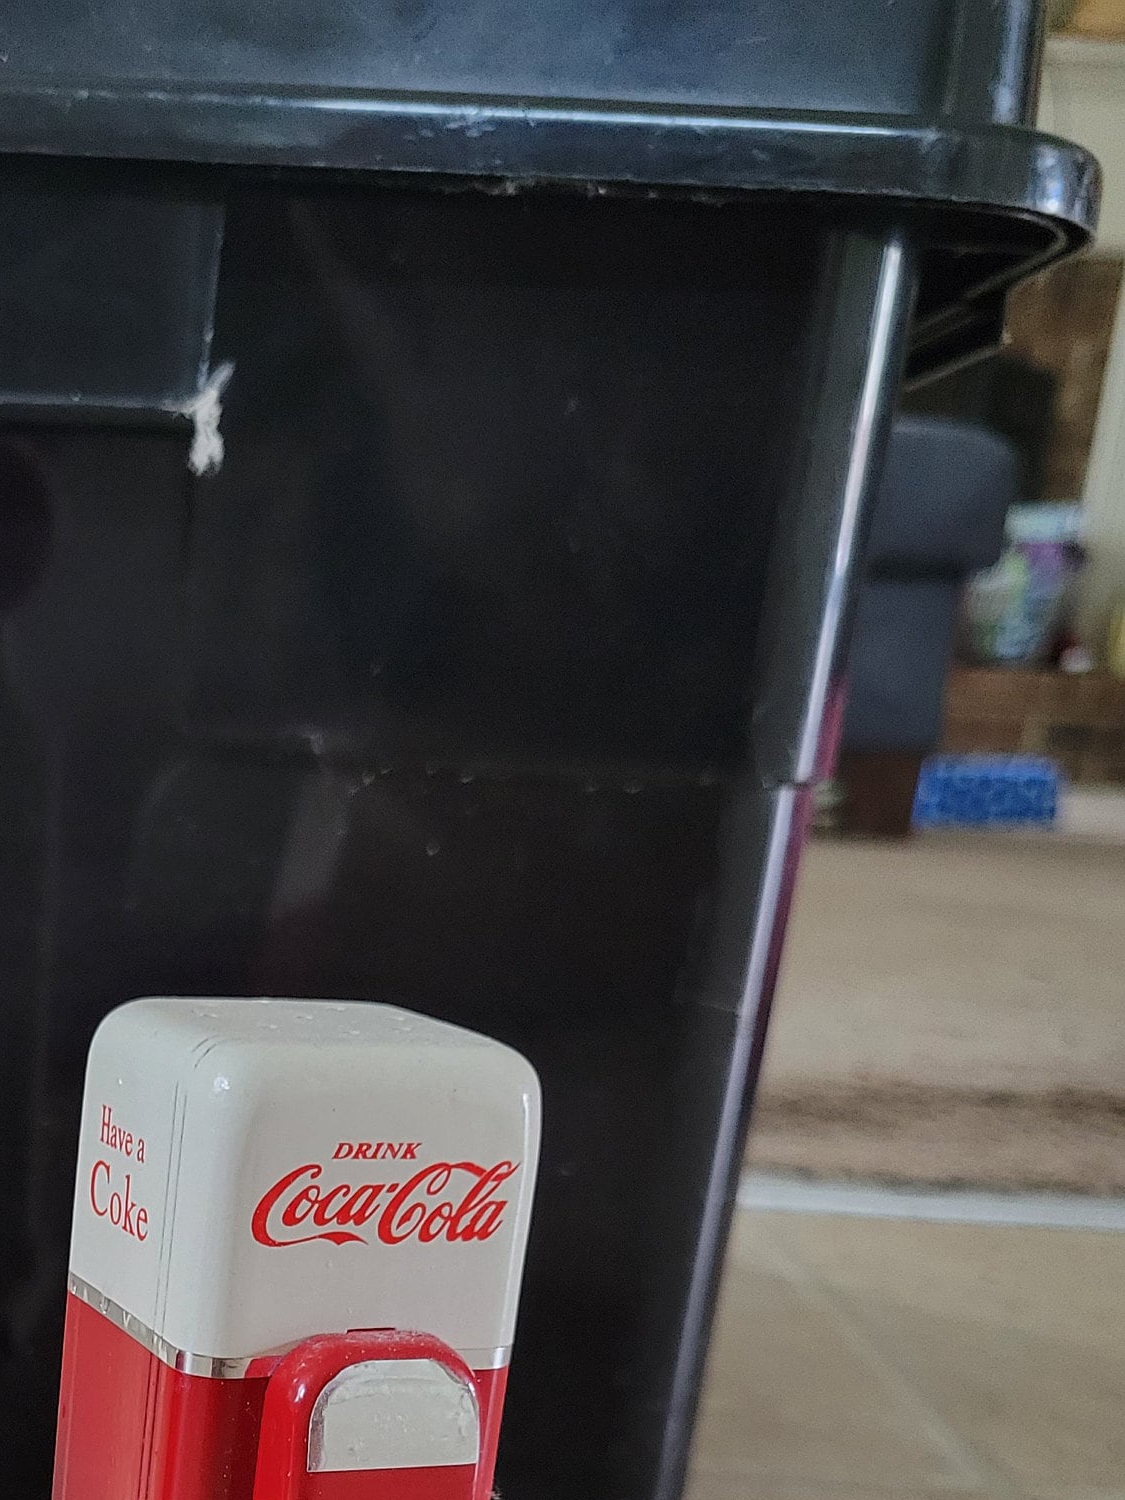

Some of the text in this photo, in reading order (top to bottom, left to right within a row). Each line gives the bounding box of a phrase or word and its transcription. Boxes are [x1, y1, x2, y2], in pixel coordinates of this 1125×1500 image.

[100, 1104, 146, 1163] Have a
[331, 1142, 423, 1160] DRINK
[90, 1160, 149, 1241] Coke
[251, 1160, 521, 1248] Coca-Cola
